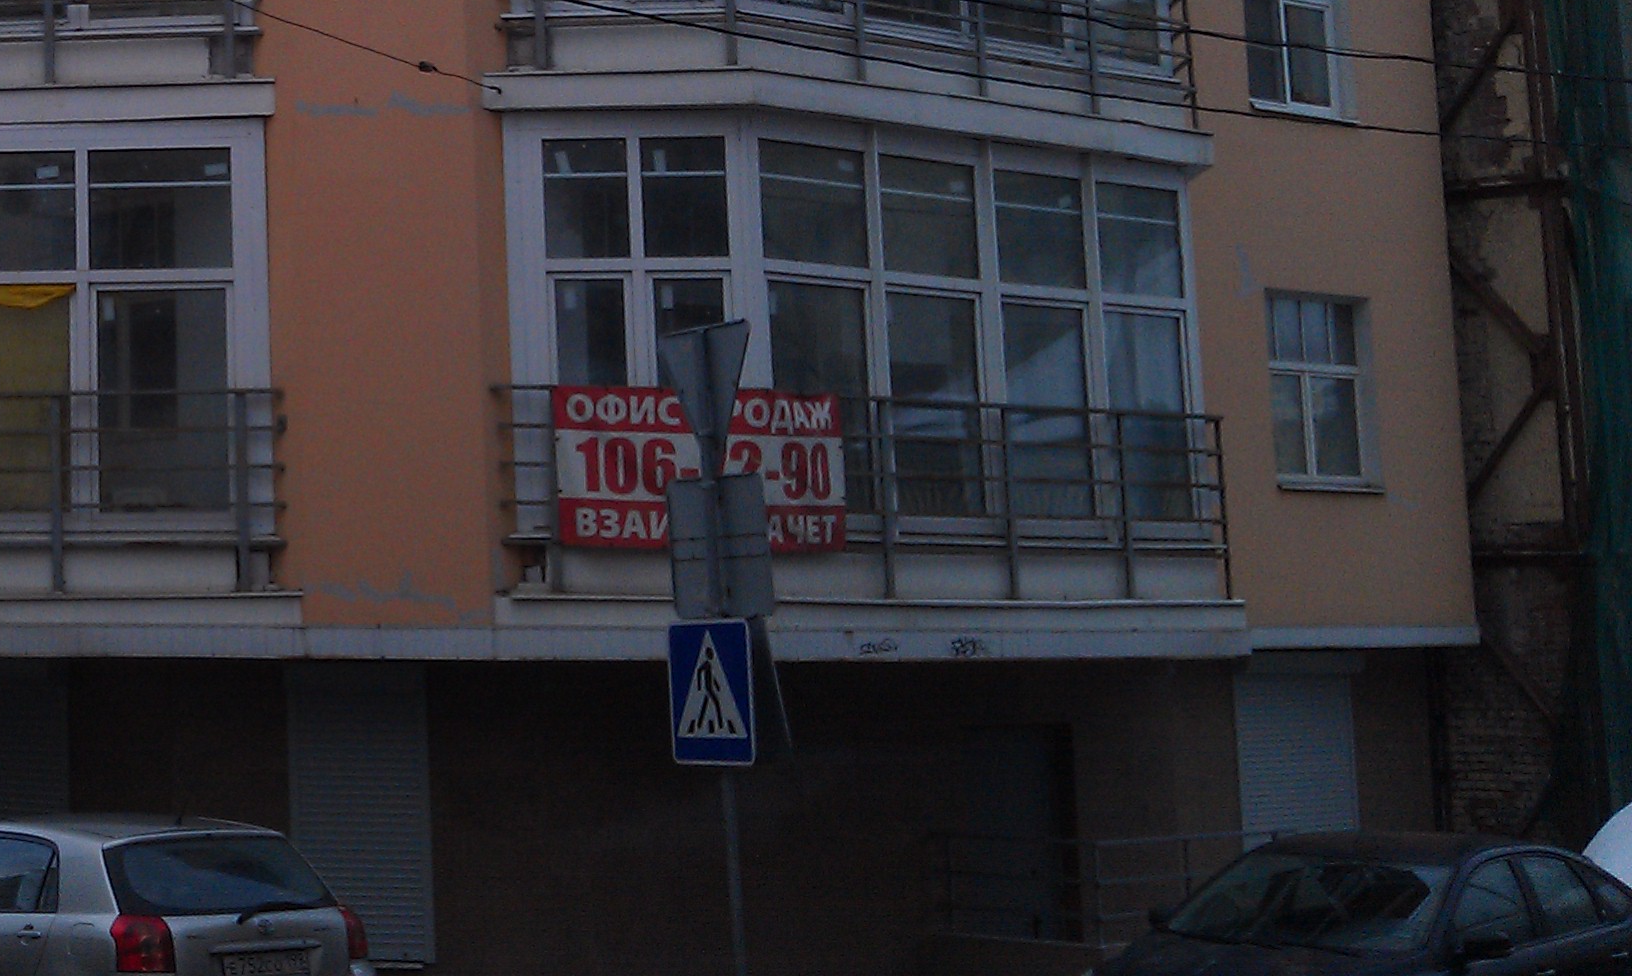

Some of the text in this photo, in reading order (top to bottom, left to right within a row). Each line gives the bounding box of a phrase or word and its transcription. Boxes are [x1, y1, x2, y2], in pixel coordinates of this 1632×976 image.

[566, 392, 833, 435] ОФИС ОДАЖ
[575, 436, 832, 500] 106-2-90
[575, 507, 837, 545] ВЗАИАЧЕТ
